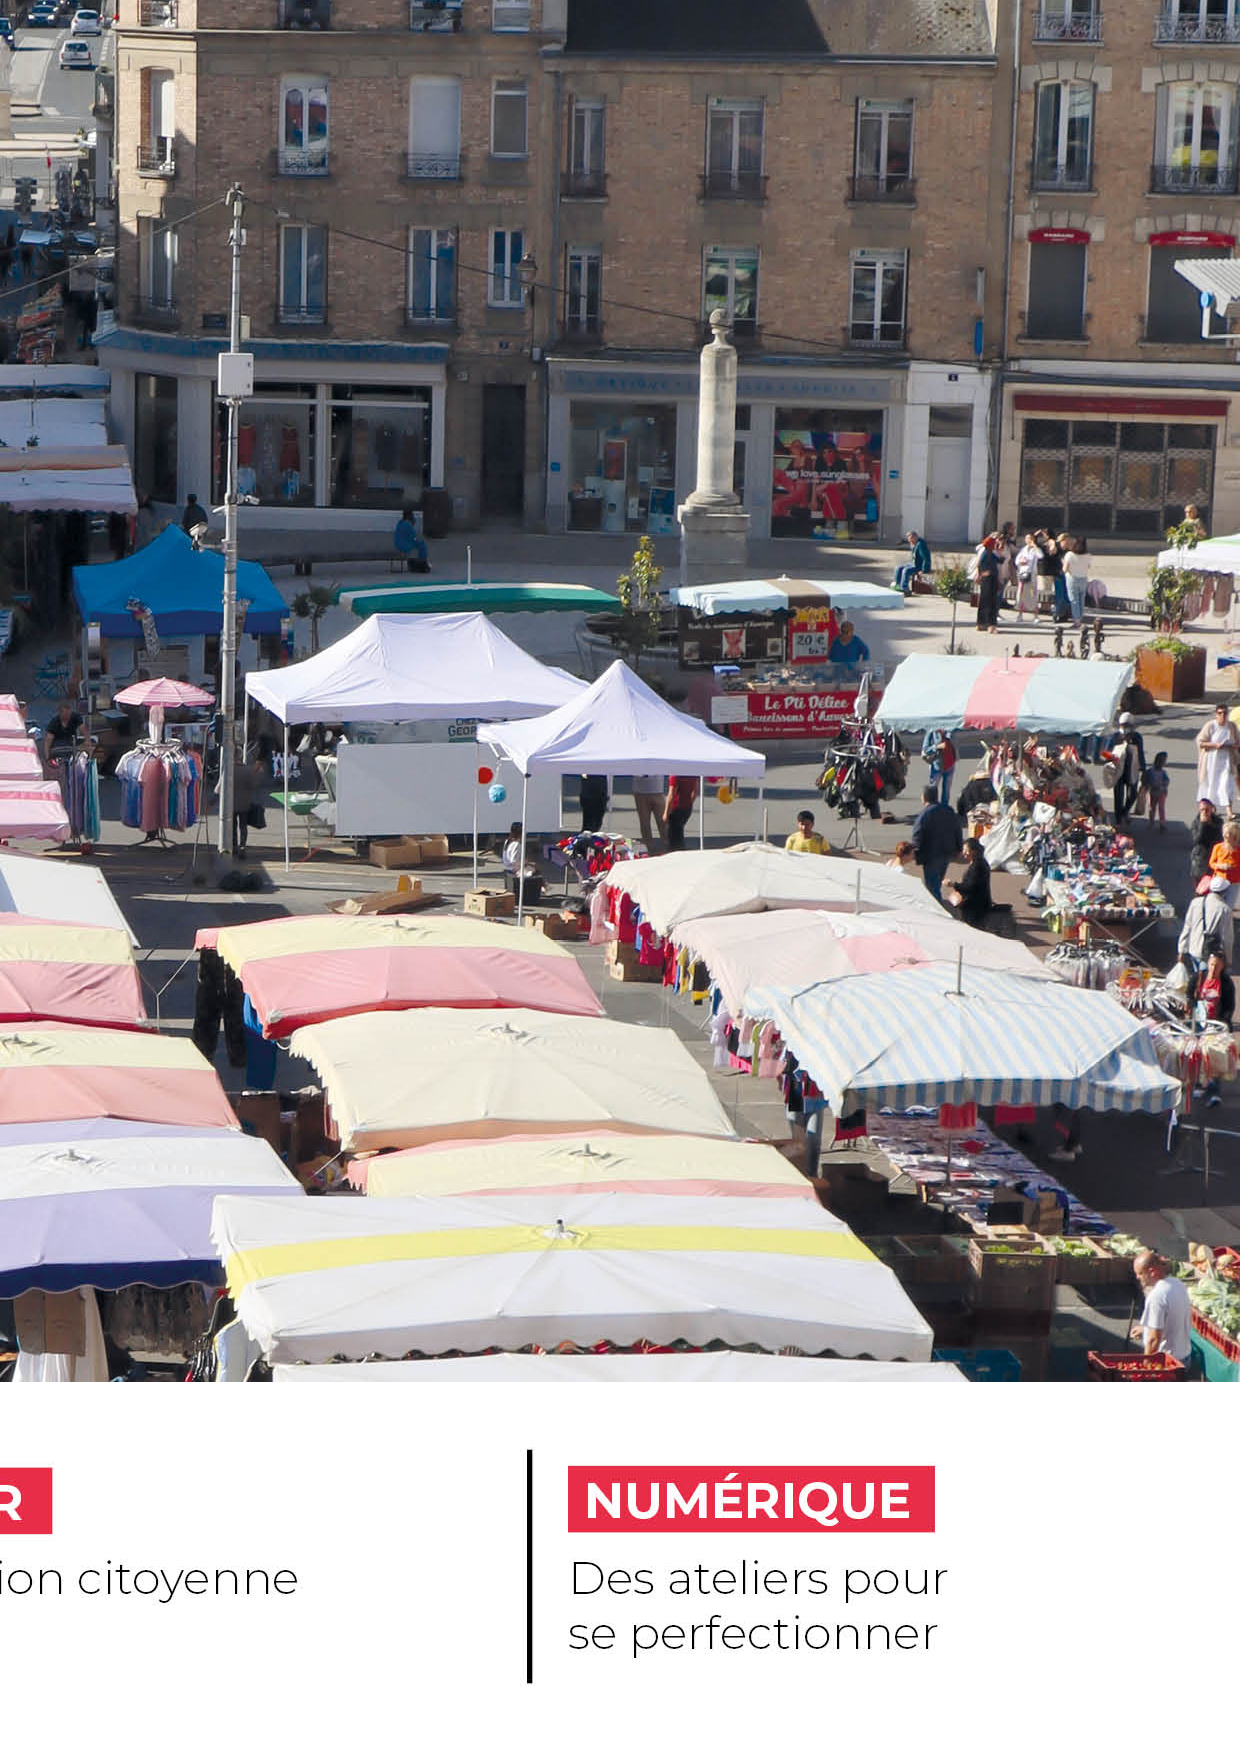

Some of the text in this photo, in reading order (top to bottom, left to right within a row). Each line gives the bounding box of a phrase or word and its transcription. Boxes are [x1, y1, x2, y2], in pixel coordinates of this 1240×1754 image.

[800, 470, 819, 479] love
[797, 634, 812, 646] 20
[764, 695, 781, 710] Le
[809, 694, 848, 709] Délice
